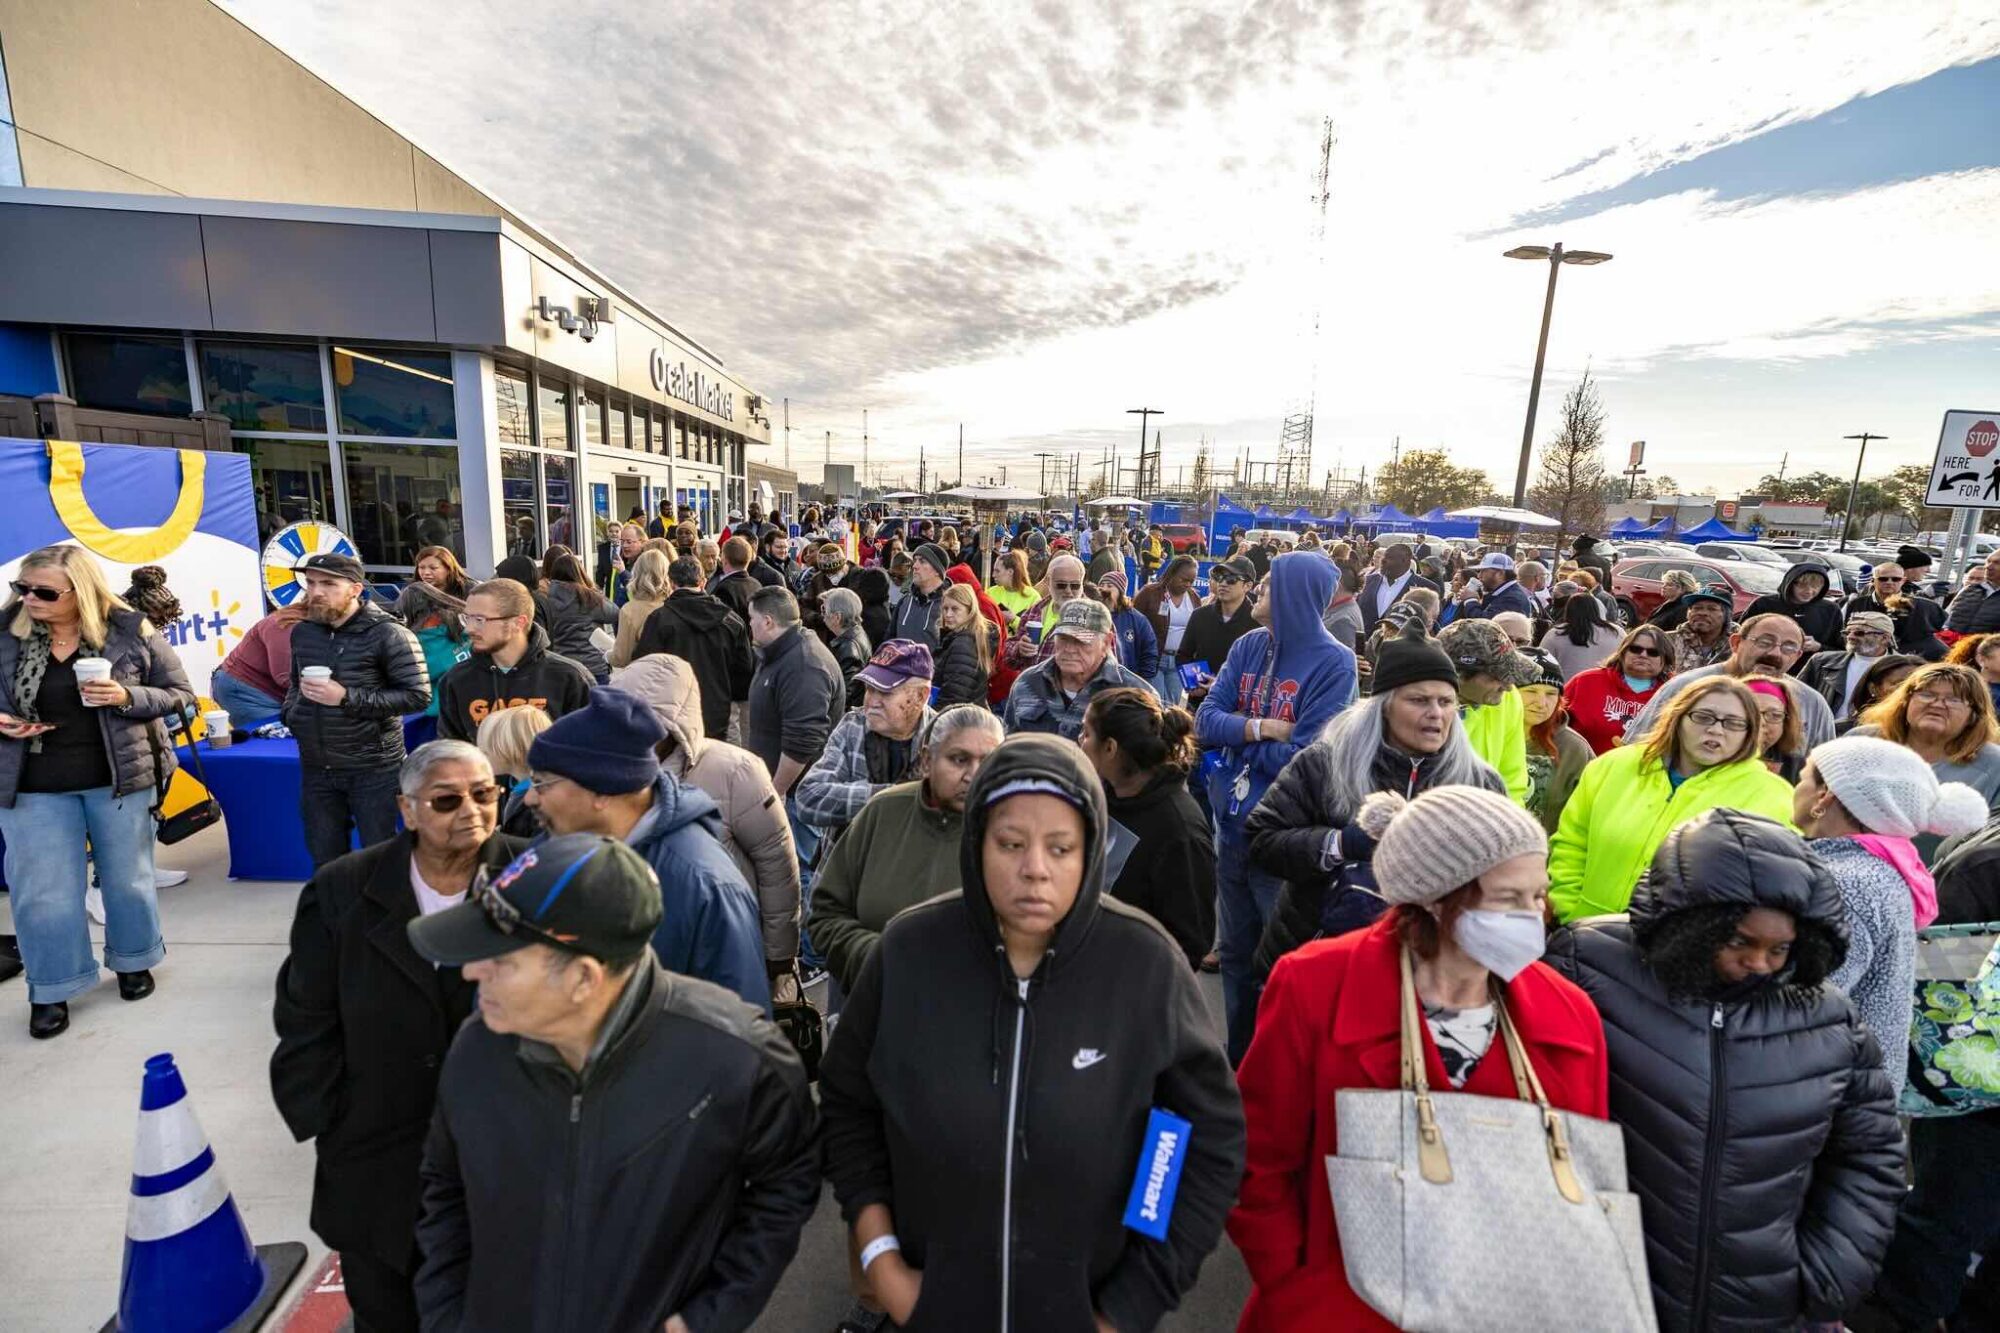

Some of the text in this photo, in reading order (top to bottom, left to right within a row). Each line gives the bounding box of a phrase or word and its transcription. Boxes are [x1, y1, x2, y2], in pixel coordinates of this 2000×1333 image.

[649, 347, 733, 422] Ocala Market
[1967, 432, 1998, 447] STOP
[1943, 456, 1971, 470] HERE
[1959, 484, 1980, 497] FOR
[163, 611, 228, 647] art+
[1140, 1130, 1178, 1222] Walmart
